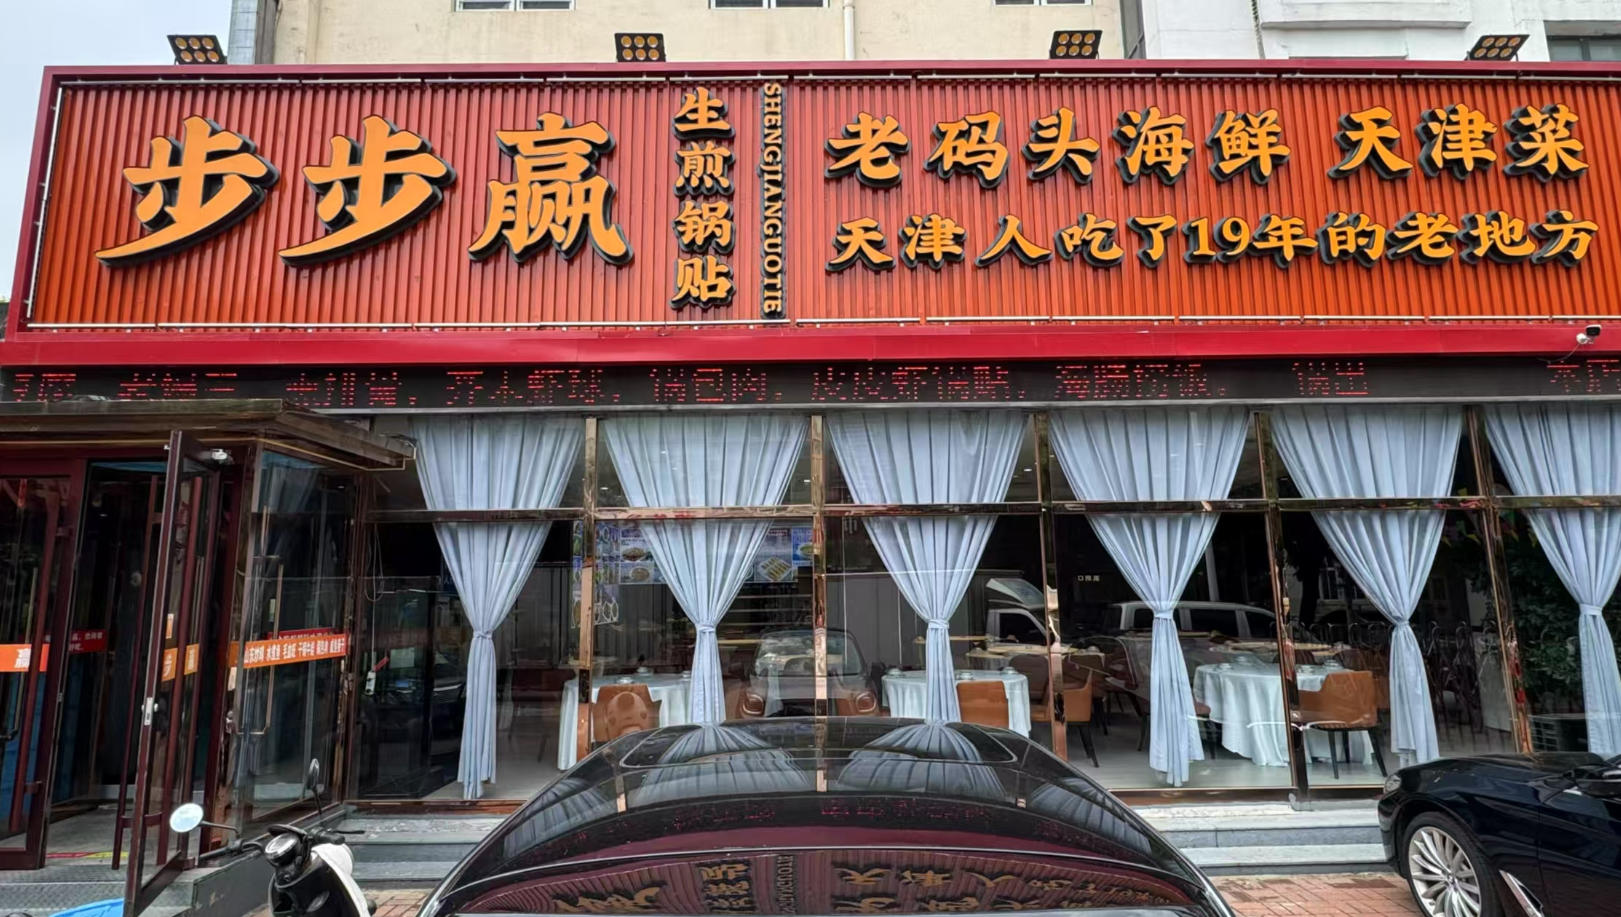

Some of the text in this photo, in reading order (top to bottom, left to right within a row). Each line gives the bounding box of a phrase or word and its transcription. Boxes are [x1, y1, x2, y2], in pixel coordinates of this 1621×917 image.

[94, 113, 630, 264] 步步赢
[671, 86, 733, 303] 生煎锅贴
[760, 82, 783, 313] SHENGJIANGUOTIE
[827, 103, 1591, 183] 老码头海鲜 天津菜
[832, 209, 1601, 268] 天津人吃了19年的老地方
